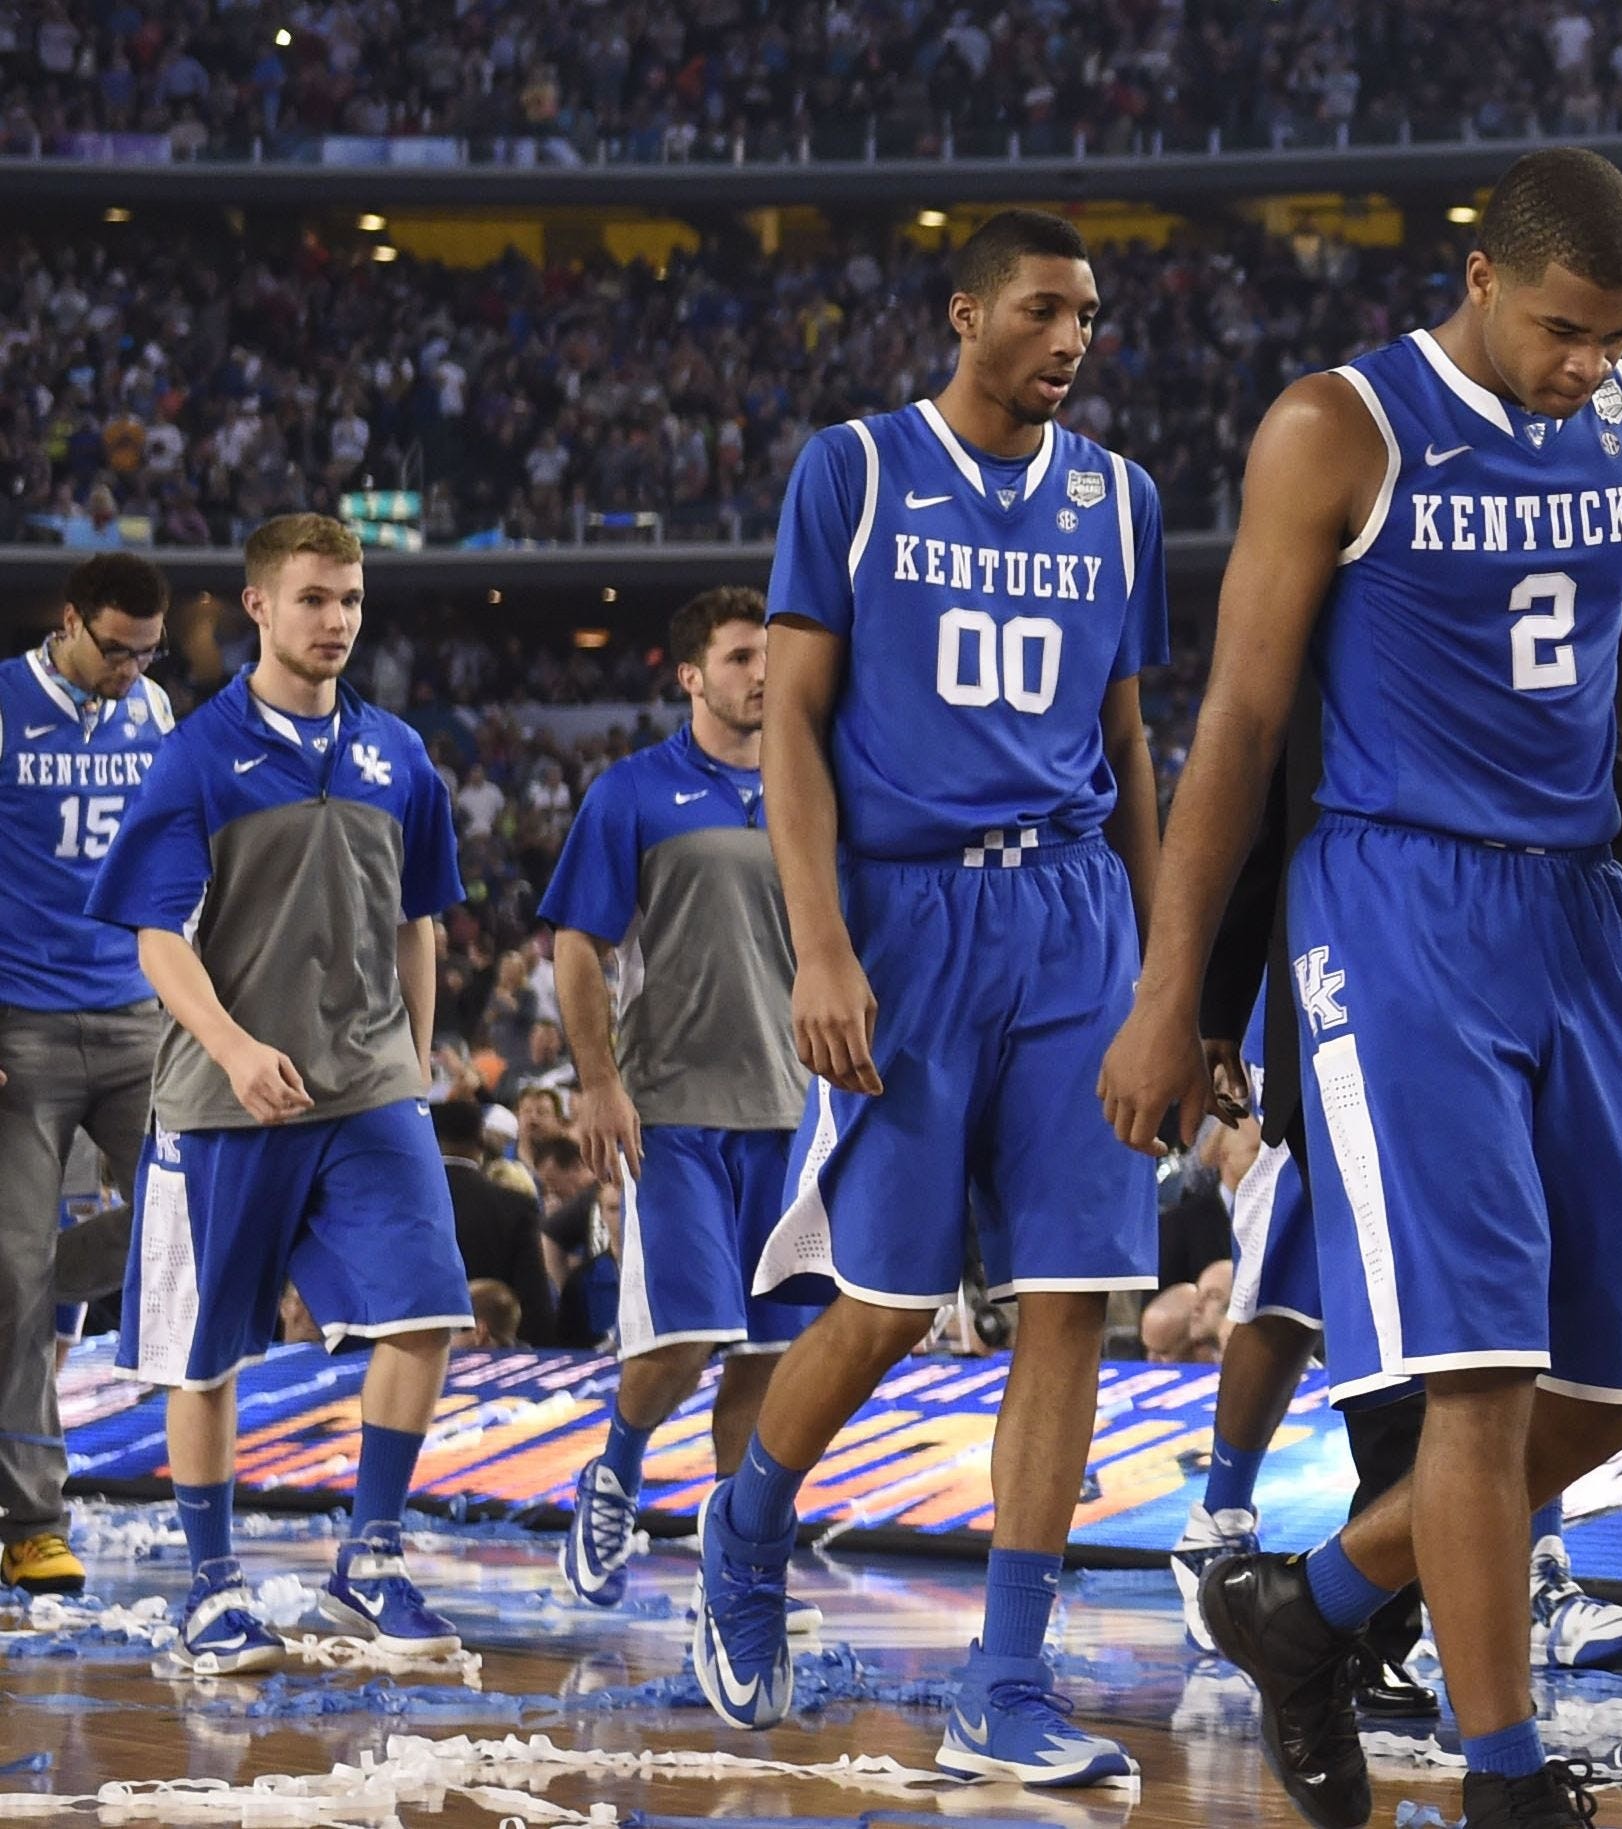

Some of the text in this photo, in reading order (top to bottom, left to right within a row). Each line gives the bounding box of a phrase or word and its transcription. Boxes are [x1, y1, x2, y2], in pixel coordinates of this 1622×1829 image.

[1058, 510, 1077, 530] SEC
[894, 534, 1102, 601] KENTUCKY
[937, 608, 1063, 715] 00
[1508, 571, 1577, 691] 2
[55, 796, 125, 860] 15
